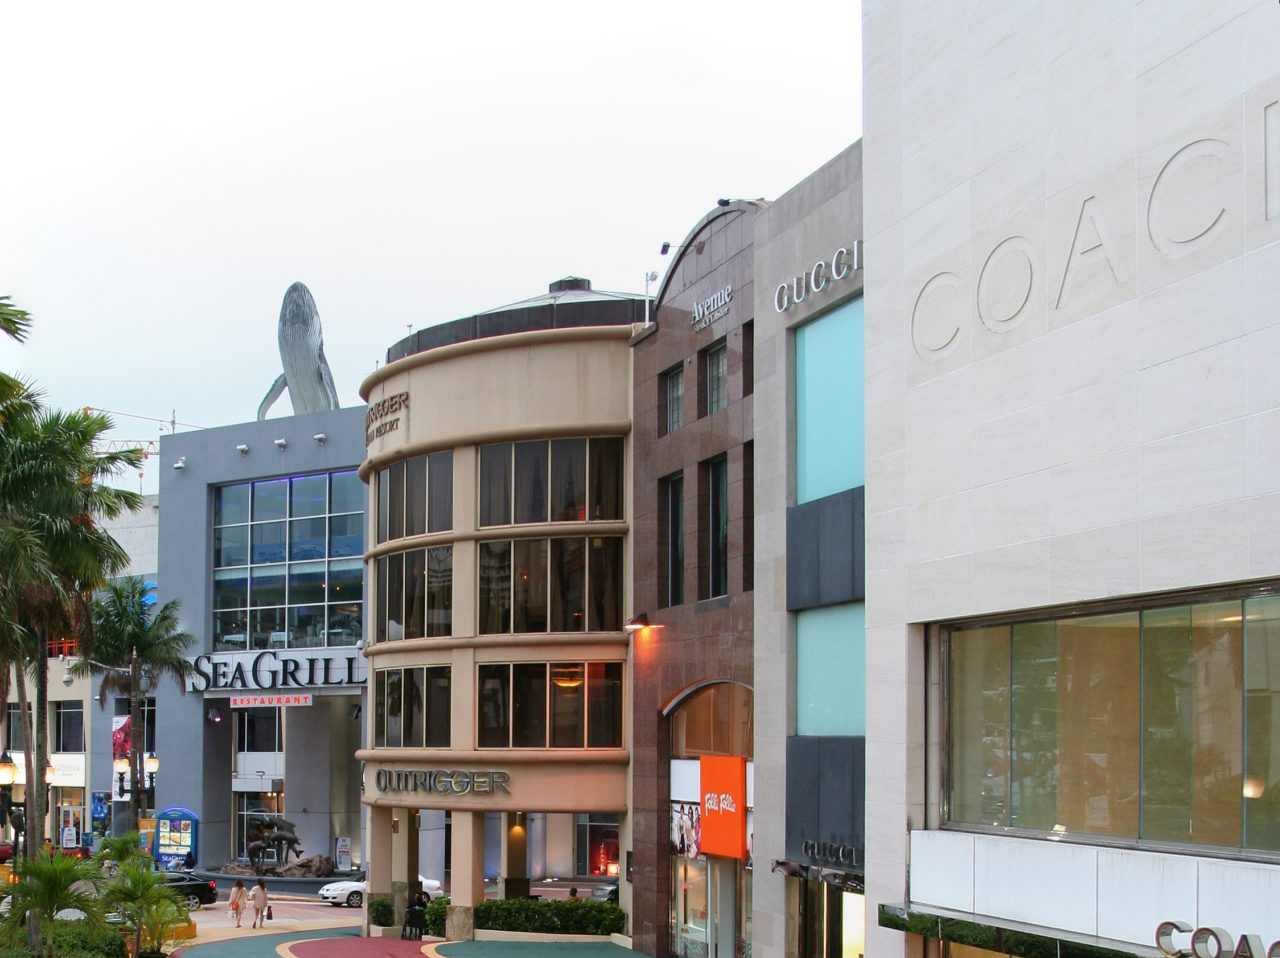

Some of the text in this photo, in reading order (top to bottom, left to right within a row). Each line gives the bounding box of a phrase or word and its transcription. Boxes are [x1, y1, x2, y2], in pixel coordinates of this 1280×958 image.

[911, 99, 1280, 361] COAC
[775, 240, 863, 312] GUCCI
[691, 285, 732, 325] Avenue
[232, 696, 309, 705] RESTAURANT
[375, 769, 511, 794] OUTRIGGER
[705, 793, 736, 816] Folli Follie
